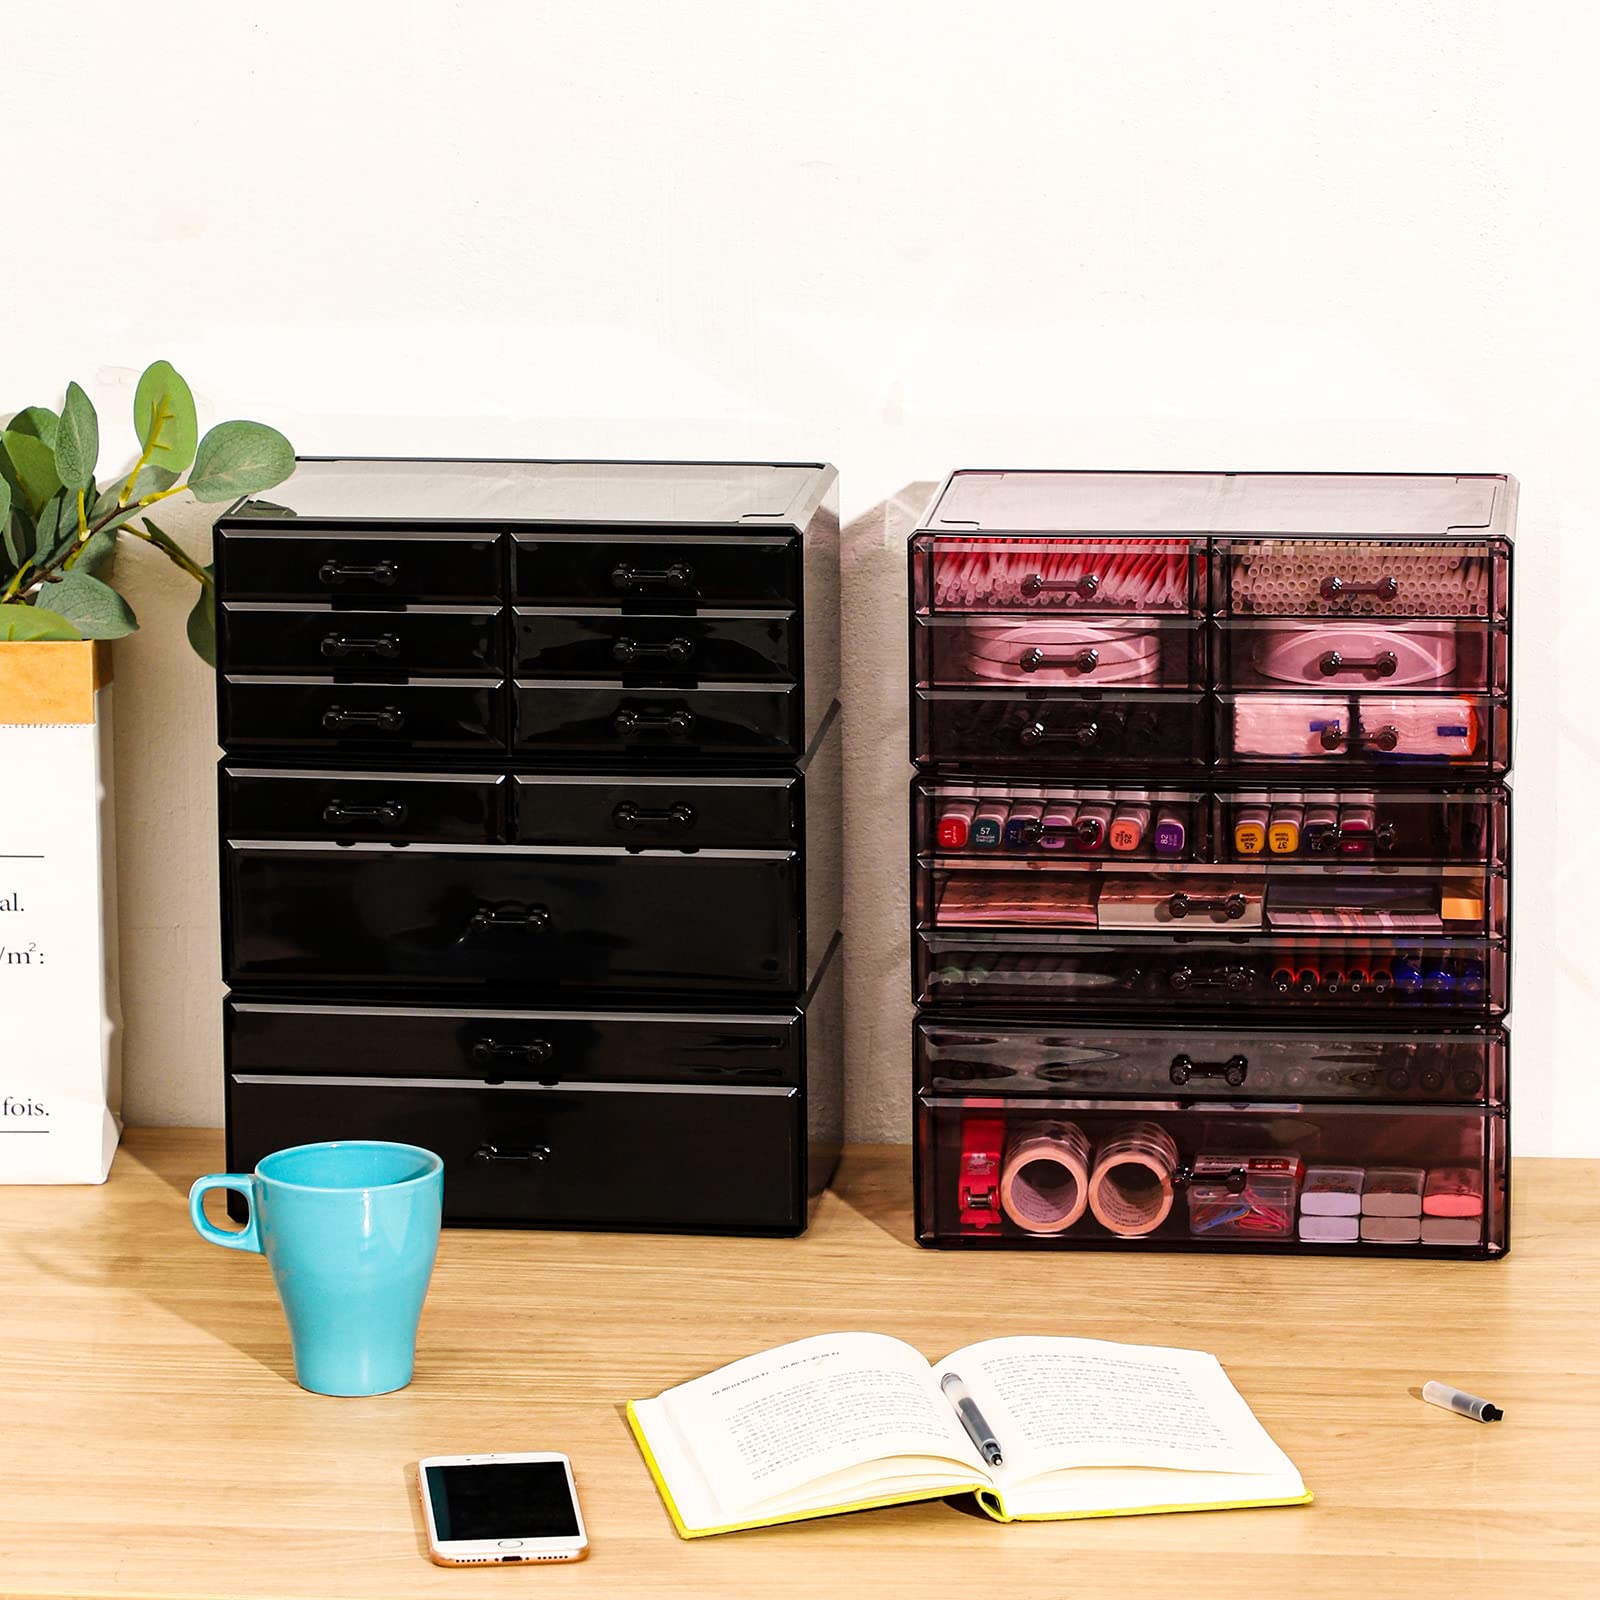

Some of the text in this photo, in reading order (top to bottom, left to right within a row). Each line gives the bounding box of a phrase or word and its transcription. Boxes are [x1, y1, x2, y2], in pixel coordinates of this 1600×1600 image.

[980, 827, 991, 835] 57
[1160, 834, 1169, 845] 82
[1277, 841, 1288, 850] 37
[3, 1096, 50, 1117] fois.
